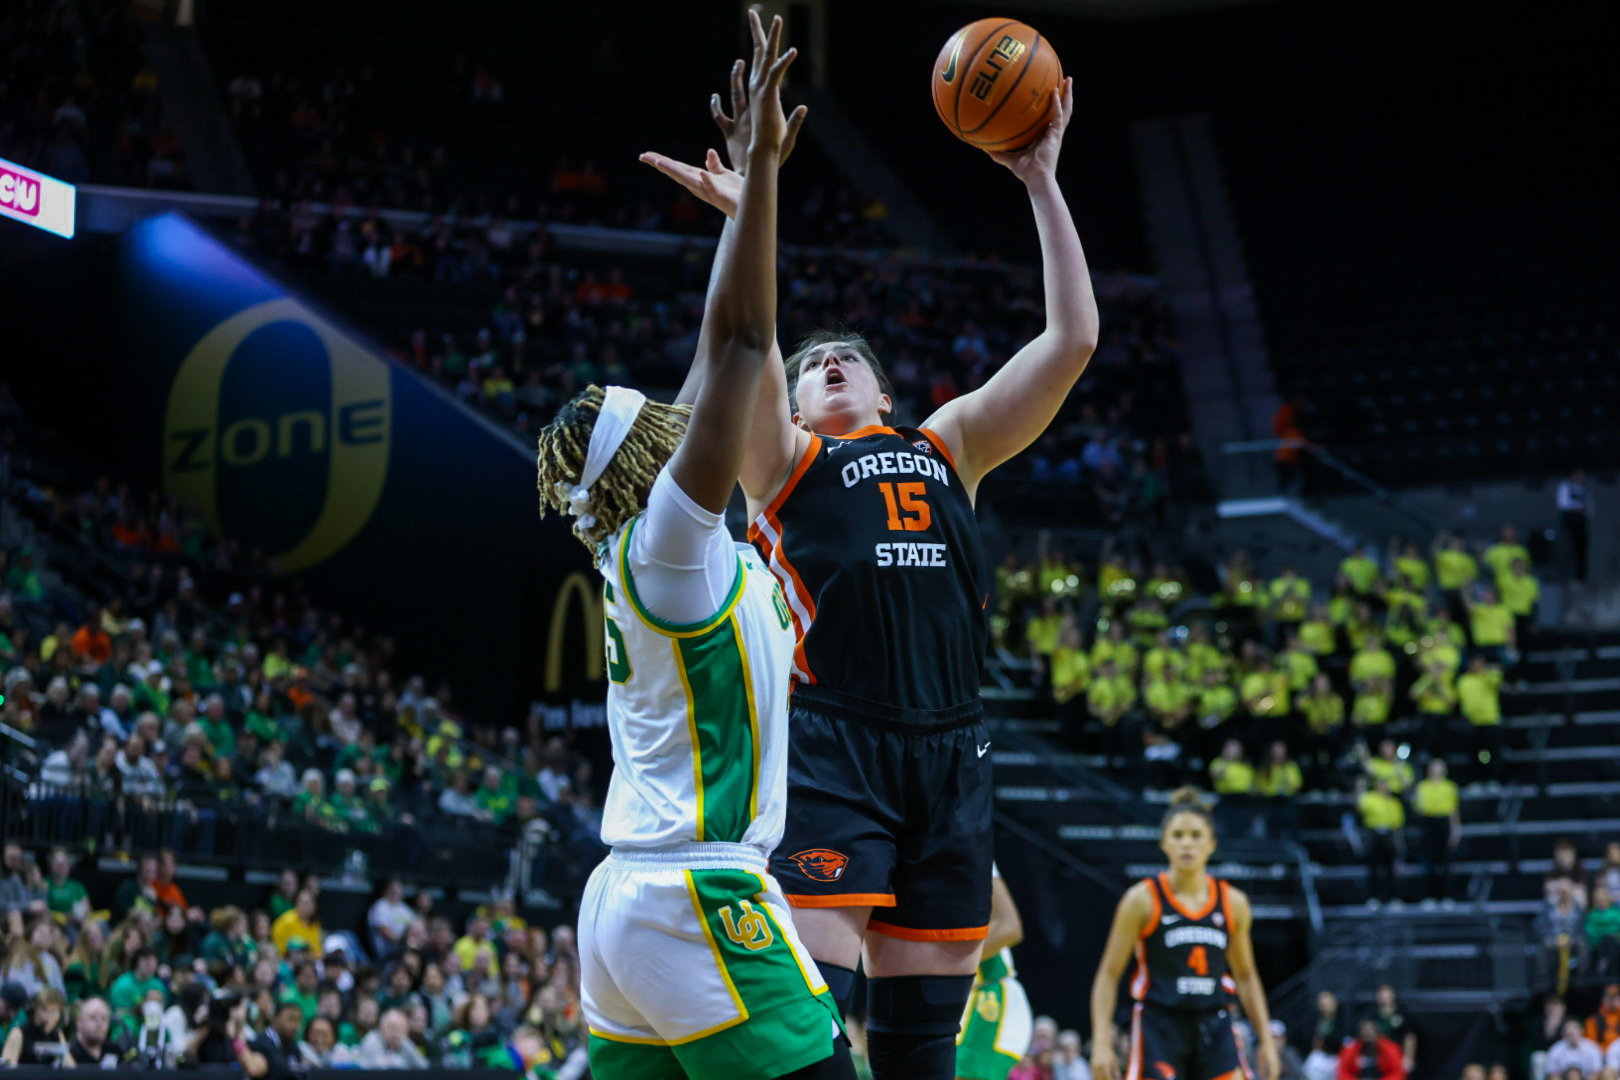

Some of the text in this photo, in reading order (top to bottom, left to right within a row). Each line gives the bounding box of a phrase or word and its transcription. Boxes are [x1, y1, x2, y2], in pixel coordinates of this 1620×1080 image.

[968, 35, 1019, 101] ELITE
[841, 452, 949, 488] OREGON
[878, 482, 931, 531] 15
[875, 543, 946, 567] STATE
[718, 900, 773, 951] UO
[1187, 945, 1208, 976] 4
